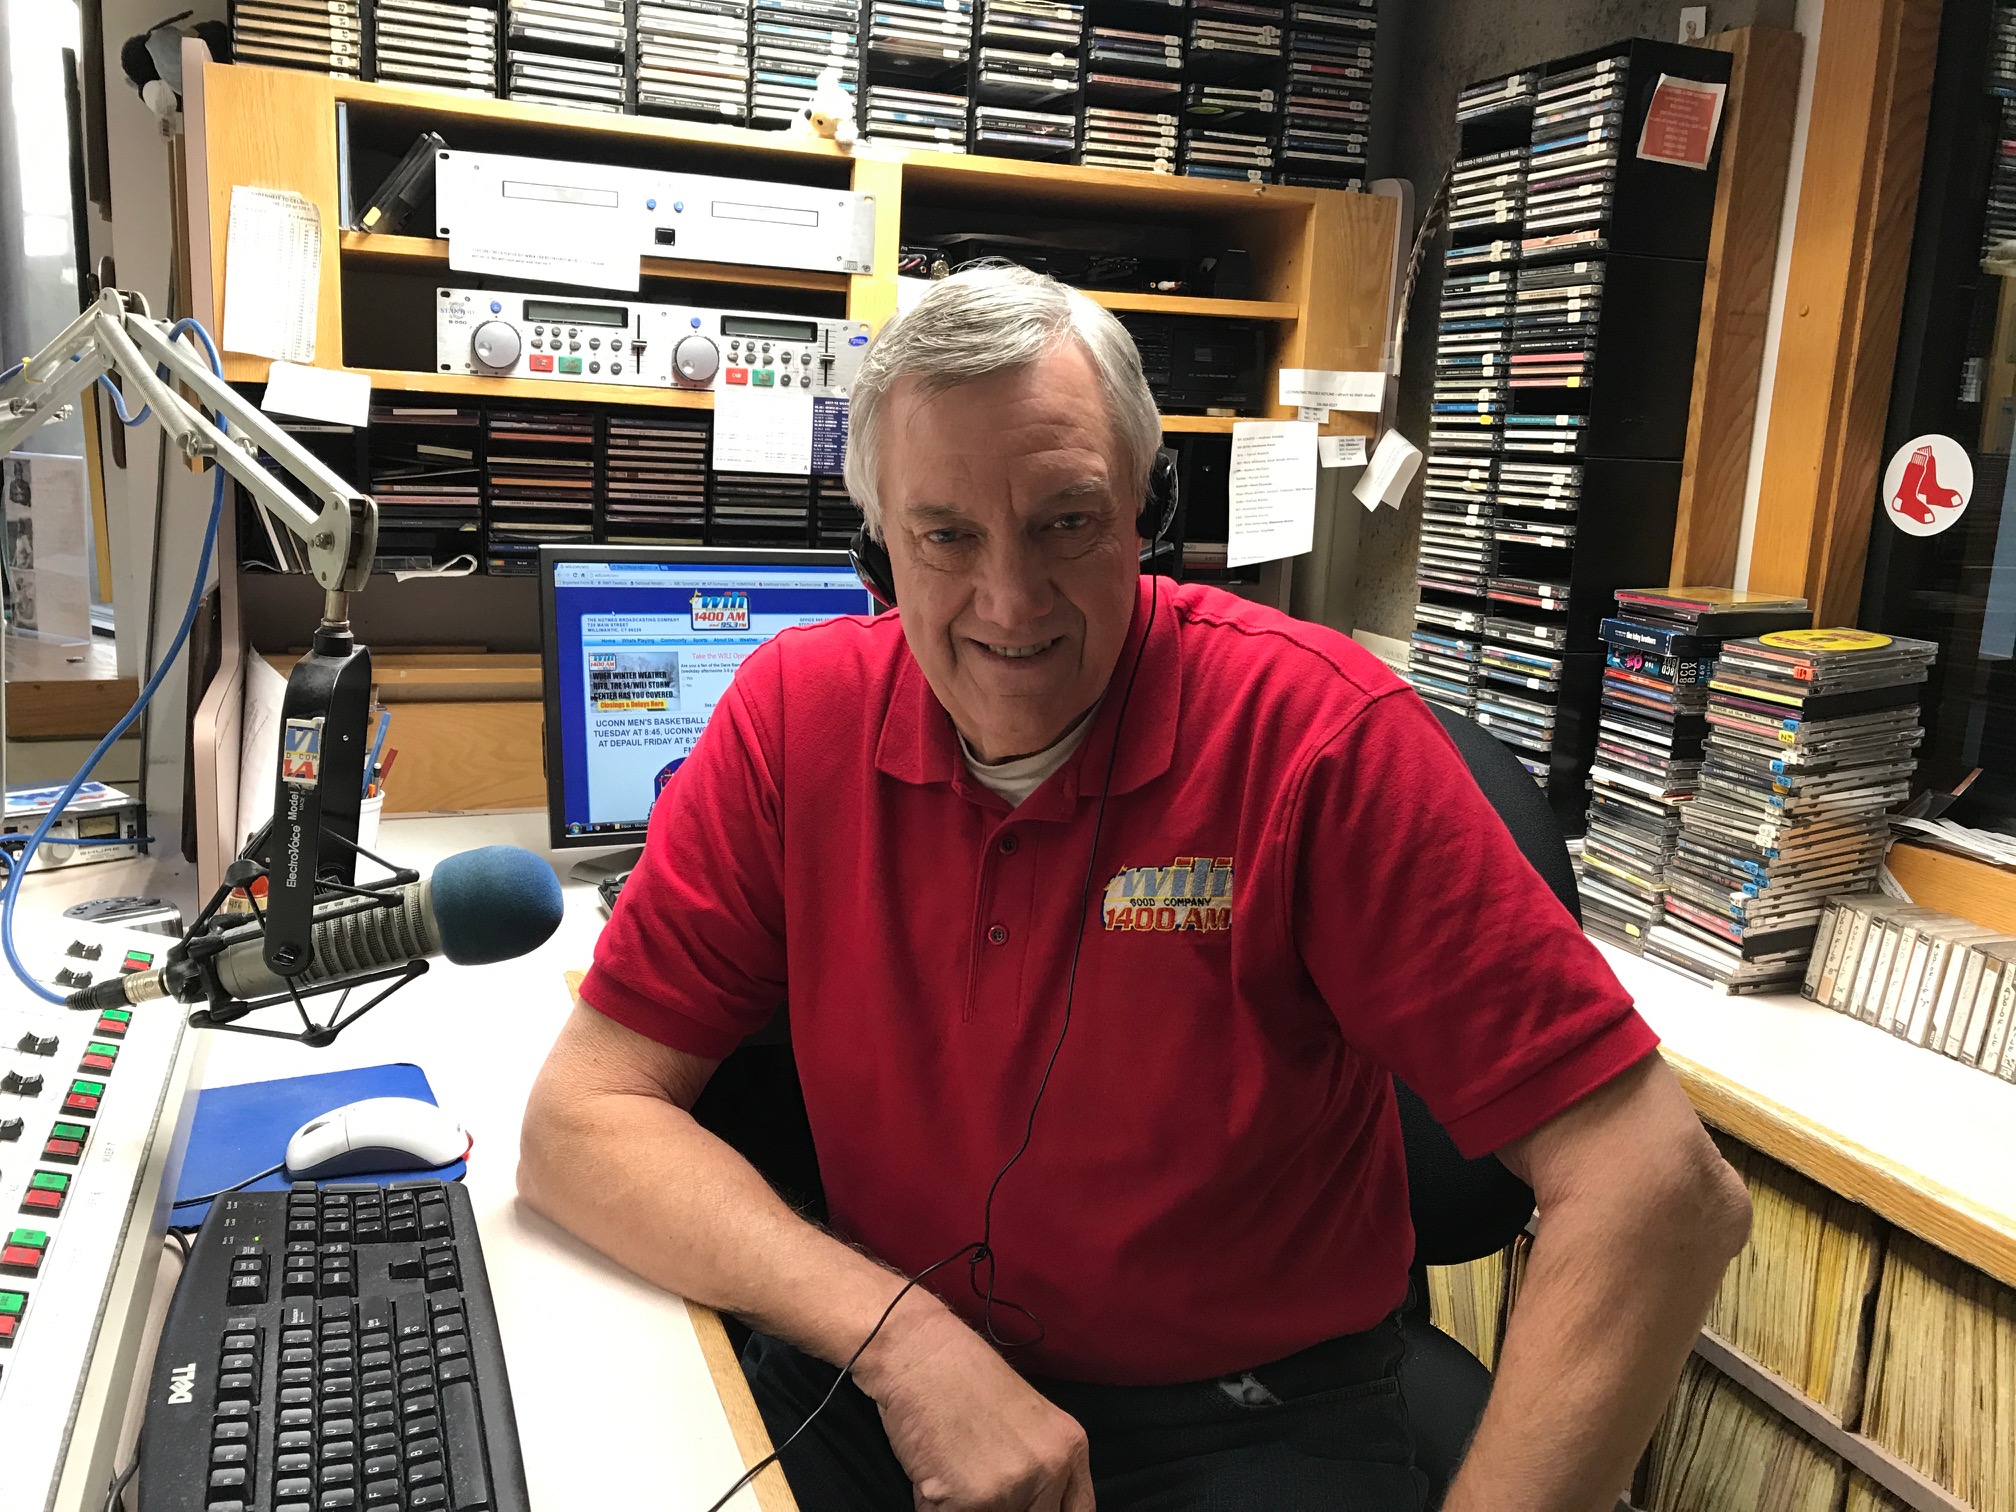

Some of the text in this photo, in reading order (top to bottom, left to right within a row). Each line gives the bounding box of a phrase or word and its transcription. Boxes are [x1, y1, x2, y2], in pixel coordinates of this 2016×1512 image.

[694, 612, 746, 622] 1400 AM
[612, 671, 637, 680] WINTER
[638, 671, 667, 679] WEATHER
[1680, 662, 1689, 684] 8CD
[1687, 662, 1698, 684] BOX
[648, 681, 670, 689] STORM
[593, 690, 675, 700] CENTER HAS YOU COVERED.
[600, 701, 625, 709] Closings
[630, 701, 650, 709] Delays
[595, 717, 705, 728] UCONN MEN'S BASKETBALL
[593, 727, 693, 738] TUESDAY AT 8:45, UCONN
[598, 739, 610, 747] AT
[610, 738, 643, 747] DEPAUL
[643, 738, 673, 746] FRIDAY
[287, 791, 299, 820] Model
[1130, 897, 1213, 907] GOOD COMPANY
[1105, 907, 1233, 933] 1400 AM
[168, 1362, 196, 1405] DELL
